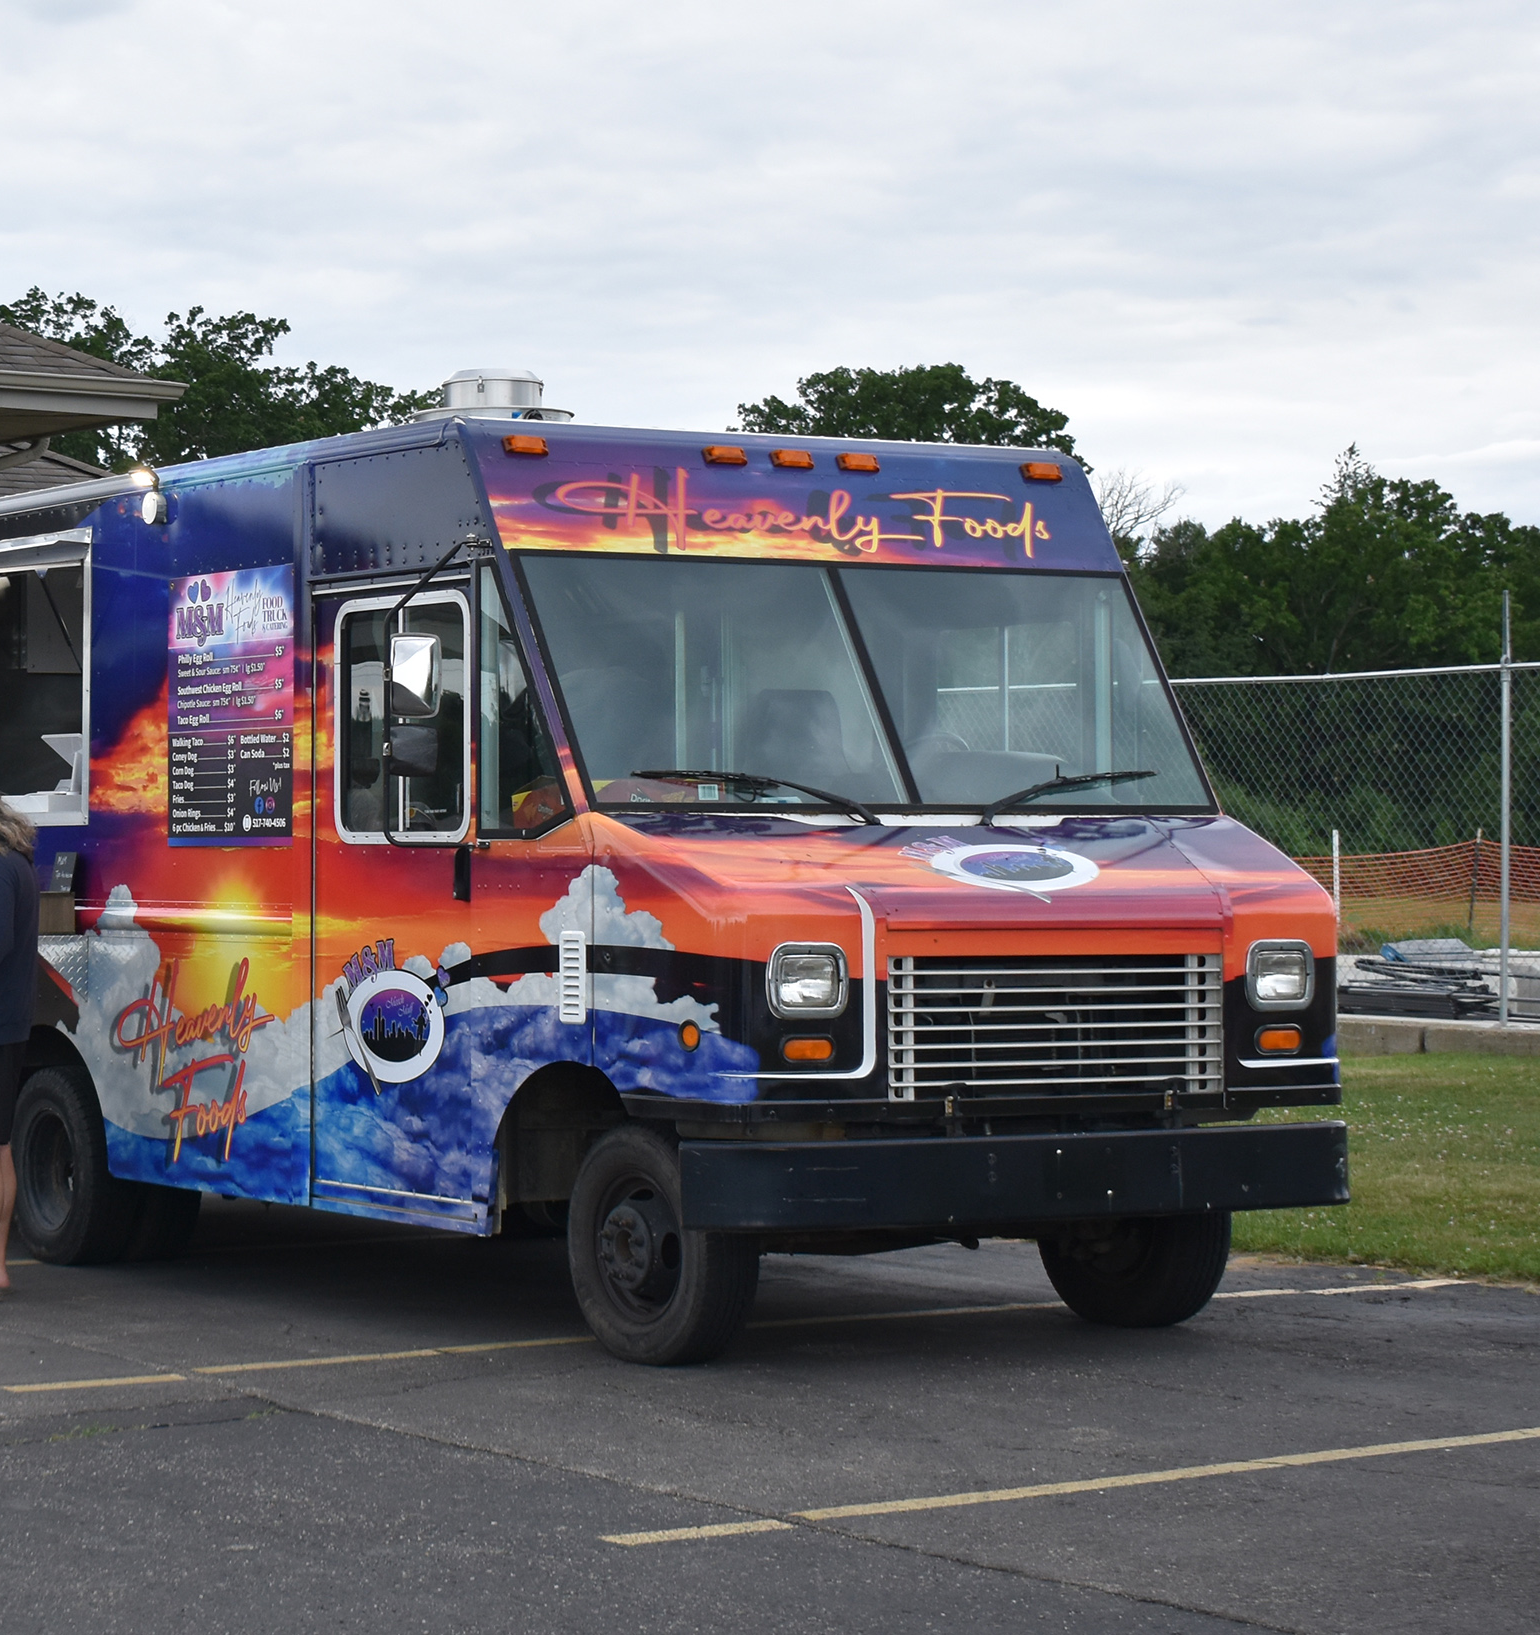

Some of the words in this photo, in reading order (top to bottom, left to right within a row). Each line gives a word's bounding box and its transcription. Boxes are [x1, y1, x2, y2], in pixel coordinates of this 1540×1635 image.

[555, 466, 924, 552] Heavenly
[890, 488, 1051, 559] Foods
[225, 578, 264, 624] Heavenly
[262, 596, 283, 610] FOOD
[262, 609, 288, 623] TRUCK
[175, 602, 224, 647] M&M
[267, 622, 289, 632] CATERING
[178, 654, 192, 666] Philly
[193, 654, 203, 666] Egg
[203, 652, 214, 662] Roll
[178, 669, 191, 678] Sweet
[195, 668, 206, 677] Sour
[223, 666, 230, 674] sm
[177, 685, 203, 696] Southwest
[203, 683, 222, 693] Chicken
[222, 683, 233, 695] Egg
[232, 681, 242, 691] Roll
[177, 699, 195, 711] Chipotle
[213, 698, 220, 707] sm
[177, 715, 188, 725] Taco
[188, 715, 199, 727] Egg
[199, 713, 210, 723] Roll
[172, 737, 191, 749] Walking
[191, 737, 204, 746] Taco
[240, 734, 260, 744] Bottled
[260, 734, 277, 744] Water
[282, 732, 290, 744] $2
[172, 753, 187, 763] Coney
[187, 752, 198, 763] Dog
[240, 749, 251, 759] Can
[251, 748, 266, 759] Soda
[282, 747, 290, 758] $2
[172, 766, 184, 776] Corn
[184, 766, 195, 778] Dog
[172, 780, 184, 790] Taco
[184, 780, 194, 792] Dog
[248, 779, 269, 797] Follow
[172, 794, 185, 804] Fries
[172, 808, 188, 818] Onion
[188, 808, 201, 820] Rings
[182, 822, 200, 832] Chicken
[204, 822, 216, 832] Fries
[897, 835, 975, 864] M&M
[342, 938, 396, 992] M&M
[117, 957, 275, 1087] Heavenly
[161, 1053, 247, 1164] Foods
